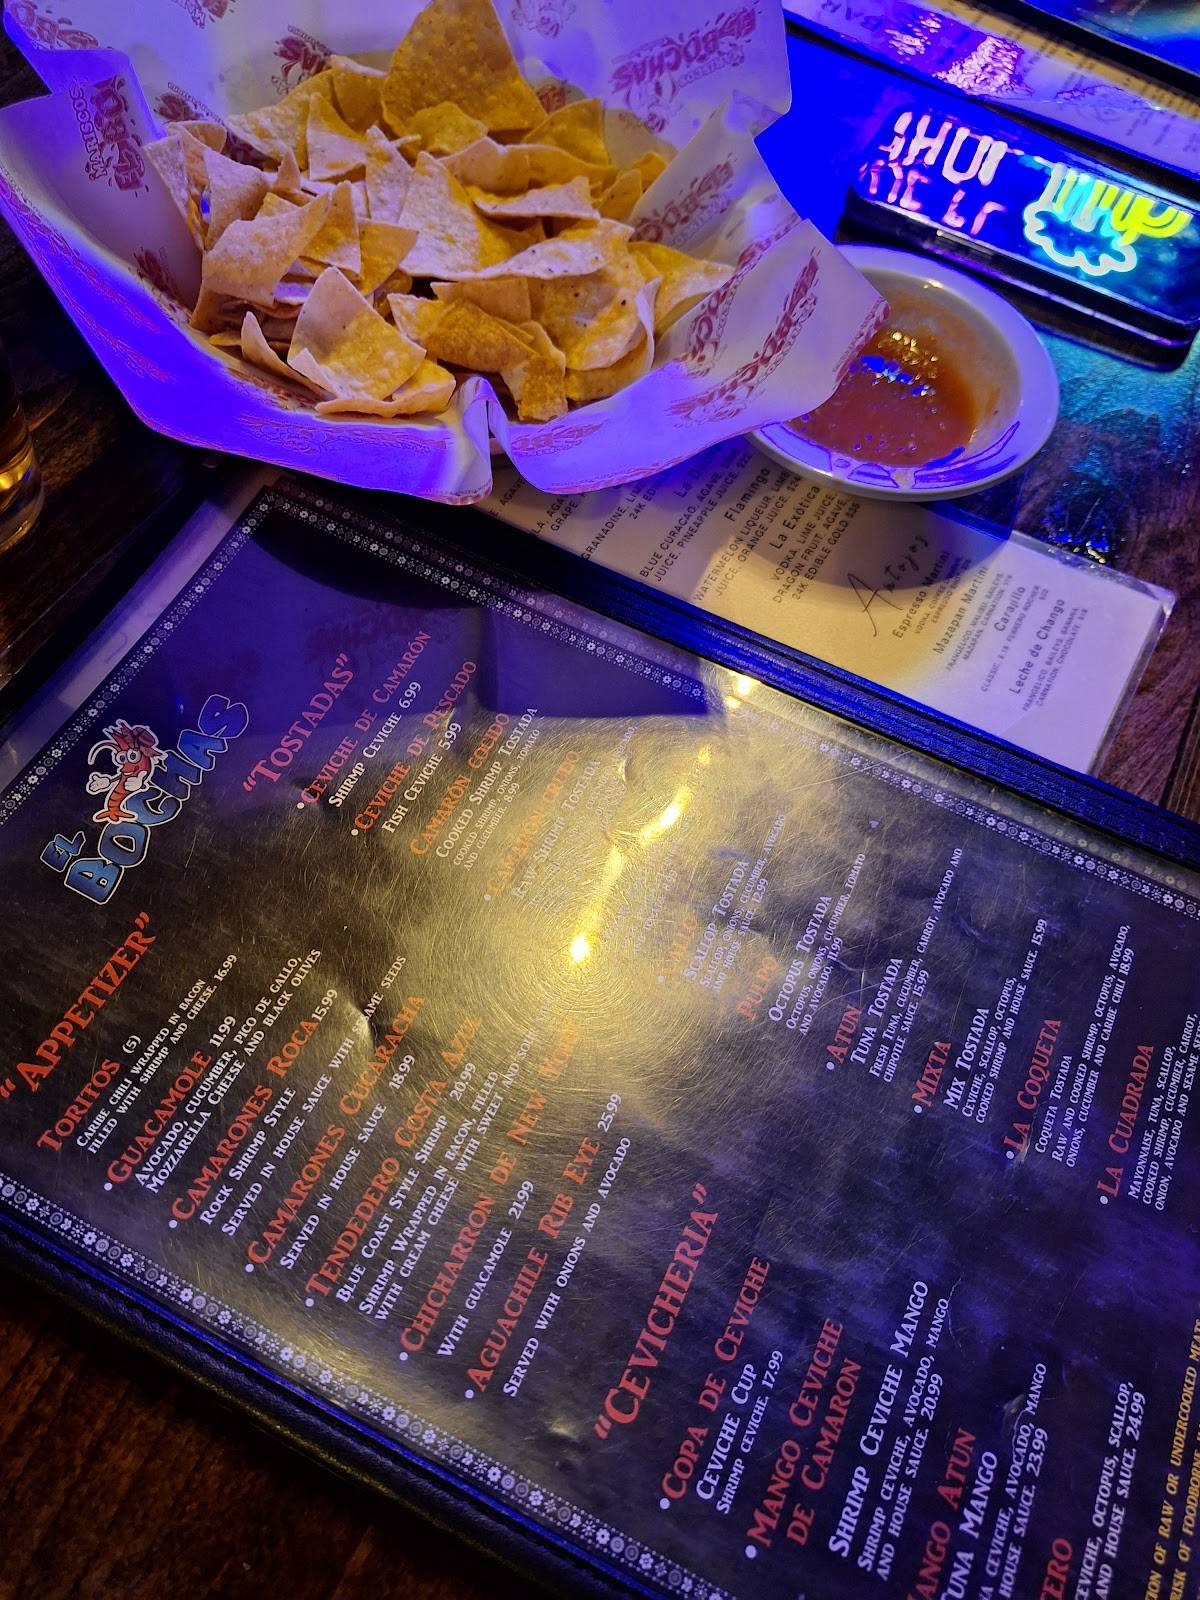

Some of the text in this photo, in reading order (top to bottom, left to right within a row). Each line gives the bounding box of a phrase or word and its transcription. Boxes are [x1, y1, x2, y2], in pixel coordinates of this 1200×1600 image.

[724, 465, 772, 522] Flamingo
[769, 532, 788, 550] La
[891, 589, 926, 638] Espresso
[932, 605, 967, 654] Mazapan
[960, 564, 989, 604] Martini
[993, 584, 1026, 632] Carajillo
[1008, 659, 1034, 694] Leche
[1027, 642, 1042, 657] de
[1035, 597, 1065, 641] Chango
[242, 651, 354, 791] "TOSTADAS"
[298, 629, 431, 806] CEVICHE DE CAMARÓN
[327, 680, 422, 809] SHIRMP CEVICHE 6.99
[352, 658, 478, 833] CEVICHE DE PESCADO
[381, 720, 463, 834] FISH CEVICHE 5.99
[408, 710, 511, 858] CAMARÓN COCIDO
[434, 705, 538, 859] COOKED SHRIMP TOSTADA
[38, 691, 248, 906] EL BOCHAS
[682, 858, 749, 980] SCALLOP TOSTADA
[735, 954, 779, 1020] PULPO
[765, 893, 832, 1021] OCTOPUS TOSTADA
[870, 846, 962, 1076] FRESH TUNA, CUCUMBER, CARROT, AVOCADO AND
[1118, 948, 1135, 975] 18.99
[0, 910, 157, 1098] "APPETIZER"
[87, 1116, 119, 1154] FILLED
[115, 1085, 142, 1115] WITH
[138, 1045, 171, 1085] SHRIMP
[167, 1020, 189, 1044] AND
[213, 952, 238, 982] 16.99
[134, 952, 301, 1186] AVOCADO, CUCUMBER, PICO DE GALLO,
[146, 946, 322, 1194] MOZZARELLA CHEESE AND BLACK OLIVES
[823, 1004, 862, 1061] ATUN
[849, 955, 903, 1065] TUNA TOSTADA
[910, 1037, 952, 1107] MIXTA
[942, 1005, 989, 1109] MIX TOSTADA
[960, 975, 1018, 1116] CEVICHE, SCALLOP, OCTOPUS,
[1050, 923, 1131, 1161] RAW AND COOKED SHRIMP, OCTOPUS, AVOCADO,
[36, 1033, 143, 1156] TORITOS (5)
[104, 1014, 237, 1186] GUACAMOLE 11.99
[168, 987, 339, 1223] CAMARONES ROCA 15.99
[199, 1085, 296, 1225] ROCK SHRIMP STYLE
[220, 953, 407, 1237] SERVED IN HOUSE SAUCE WITH SESAME SEEDS
[244, 989, 426, 1267] CAMARONES CUCARACHA
[1002, 1015, 1062, 1151] LA COQUETA
[1034, 1053, 1074, 1153] COQUETA TOSTADA
[1095, 1041, 1154, 1197] LA CUADRADA
[1127, 1044, 1177, 1198] MAYONNAISE, TUNA, SCALLOP,
[305, 1154, 402, 1301] TENDEDERO
[391, 1076, 448, 1149] COSTA
[335, 1061, 478, 1302] BLUE COAST STYLE SHRIMP 20.99
[397, 1089, 549, 1353] CHICHARRON DE NEW
[463, 1093, 623, 1390] AGUACHILE RIB EYE 25.99
[437, 1179, 535, 1359] WITH GUACAMOLE 21.99
[502, 1136, 632, 1397] SERVED WITH ONIONS AND AVOCADO
[593, 1182, 720, 1439] "CEVICHERIA"
[658, 1256, 770, 1500] COPA DE CEVICHE
[692, 1363, 759, 1500] CEVICHE CUP
[746, 1318, 844, 1543] MANGO CEVICHE
[786, 1358, 862, 1543] DE CAMARON
[826, 1280, 931, 1555] SHRIMP CEVICHE MANGO
[856, 1298, 952, 1569] SHRIMP CEVICHE, AVOCADO, MANGO
[1026, 1427, 1048, 1474] 23.99
[1091, 1380, 1135, 1526] OCTOPUS, SCALLOP,
[934, 1428, 976, 1505] ATUN
[957, 1452, 999, 1535] MANGO
[1151, 1366, 1197, 1562] OF RAW OR UNDERCOOKED
